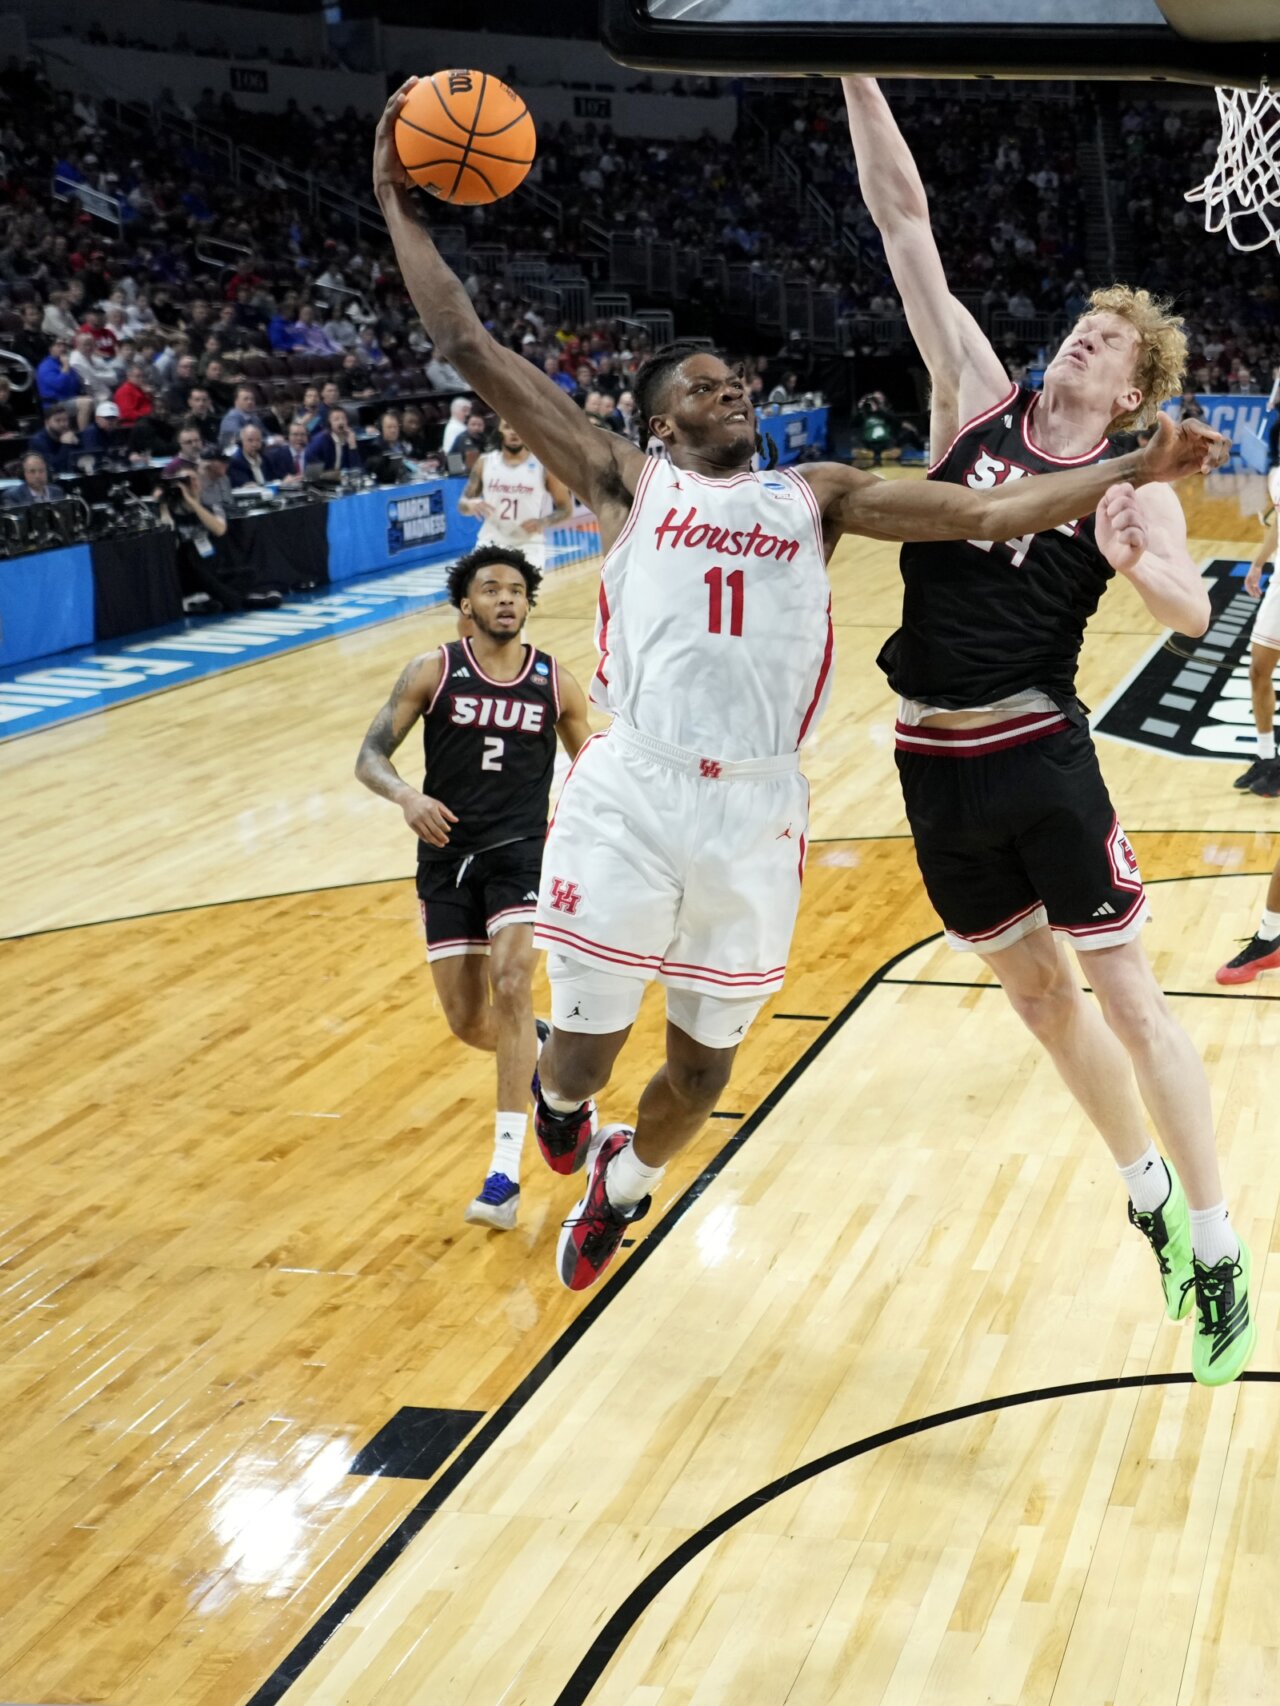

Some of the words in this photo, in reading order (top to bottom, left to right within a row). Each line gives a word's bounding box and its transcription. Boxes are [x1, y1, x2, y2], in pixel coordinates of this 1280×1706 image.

[488, 479, 535, 495] Houston
[397, 496, 430, 522] MARCH
[500, 498, 518, 521] 21
[403, 514, 446, 541] MADNESS
[655, 506, 800, 563] Houston
[704, 566, 745, 638] 11
[451, 697, 544, 733] SIUE
[481, 736, 505, 772] 2
[551, 875, 583, 916] UH
